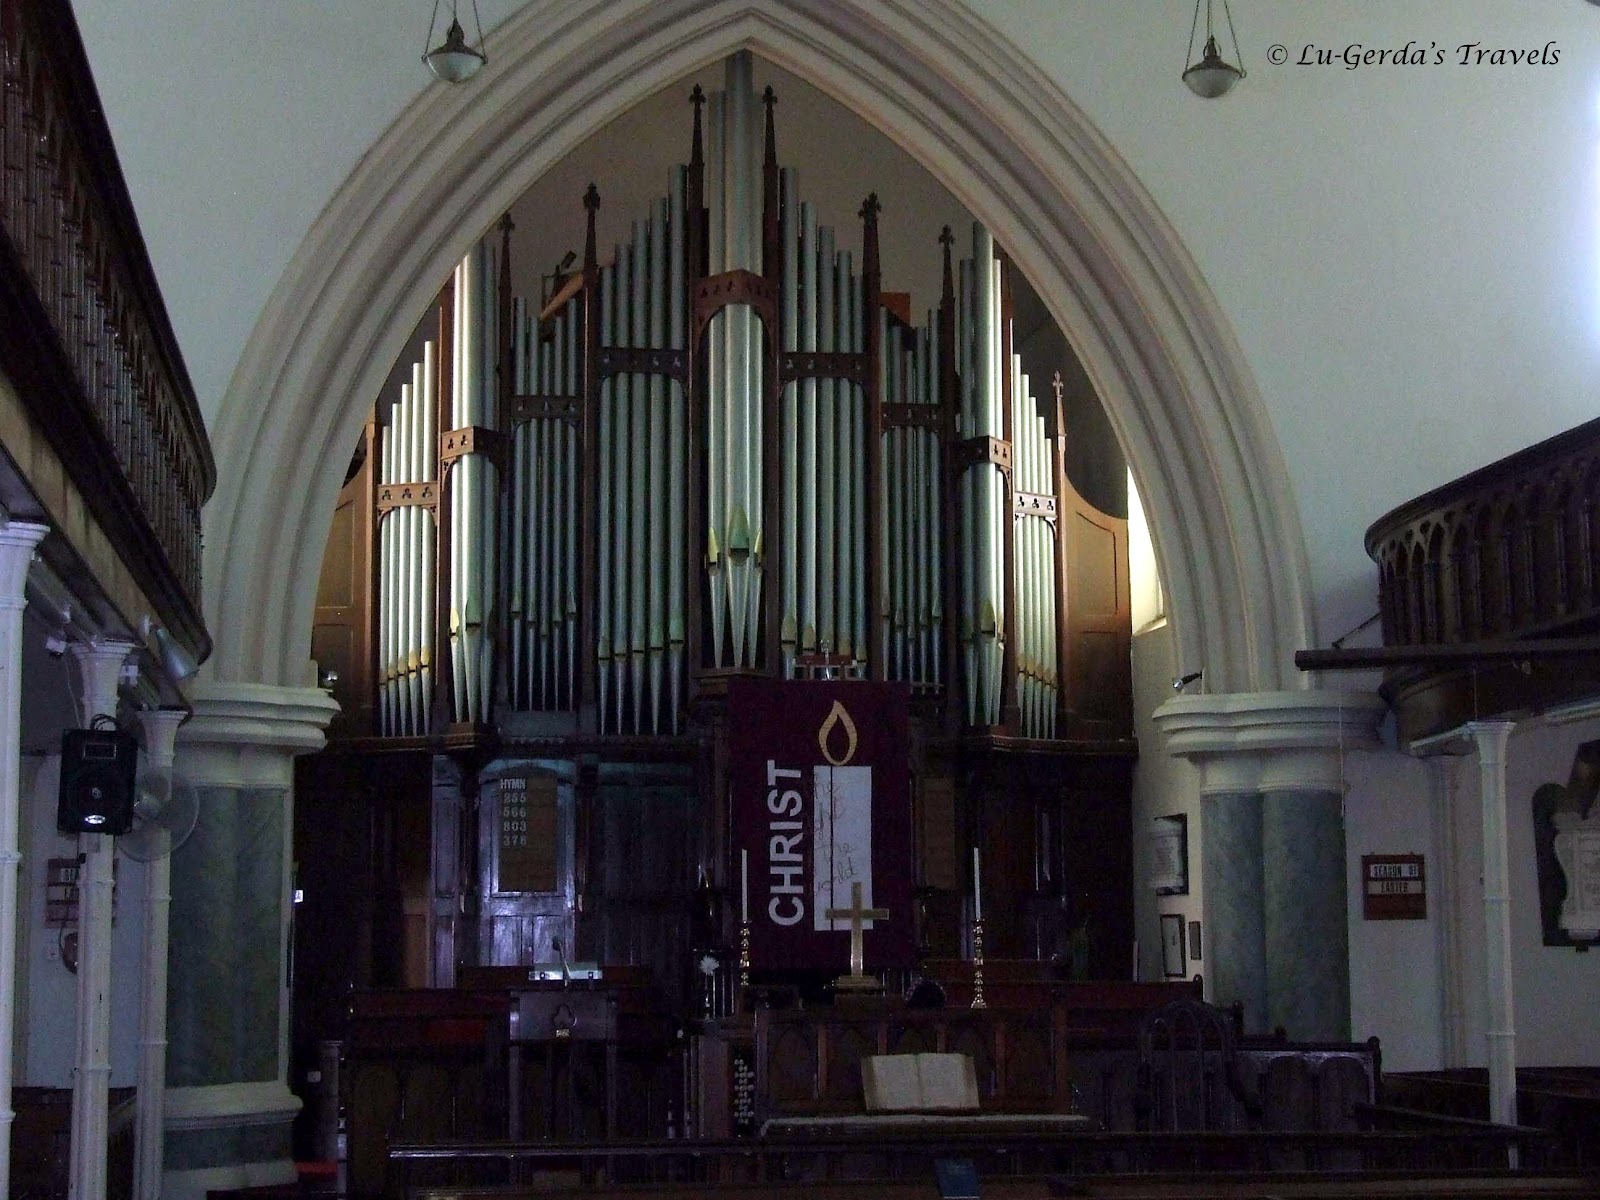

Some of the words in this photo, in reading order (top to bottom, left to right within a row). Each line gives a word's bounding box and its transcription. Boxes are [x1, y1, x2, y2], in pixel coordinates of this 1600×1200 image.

[500, 778, 526, 790] HYMN
[503, 820, 527, 832] 803
[766, 759, 805, 926] CHRIST
[1373, 865, 1402, 877] SEASON
